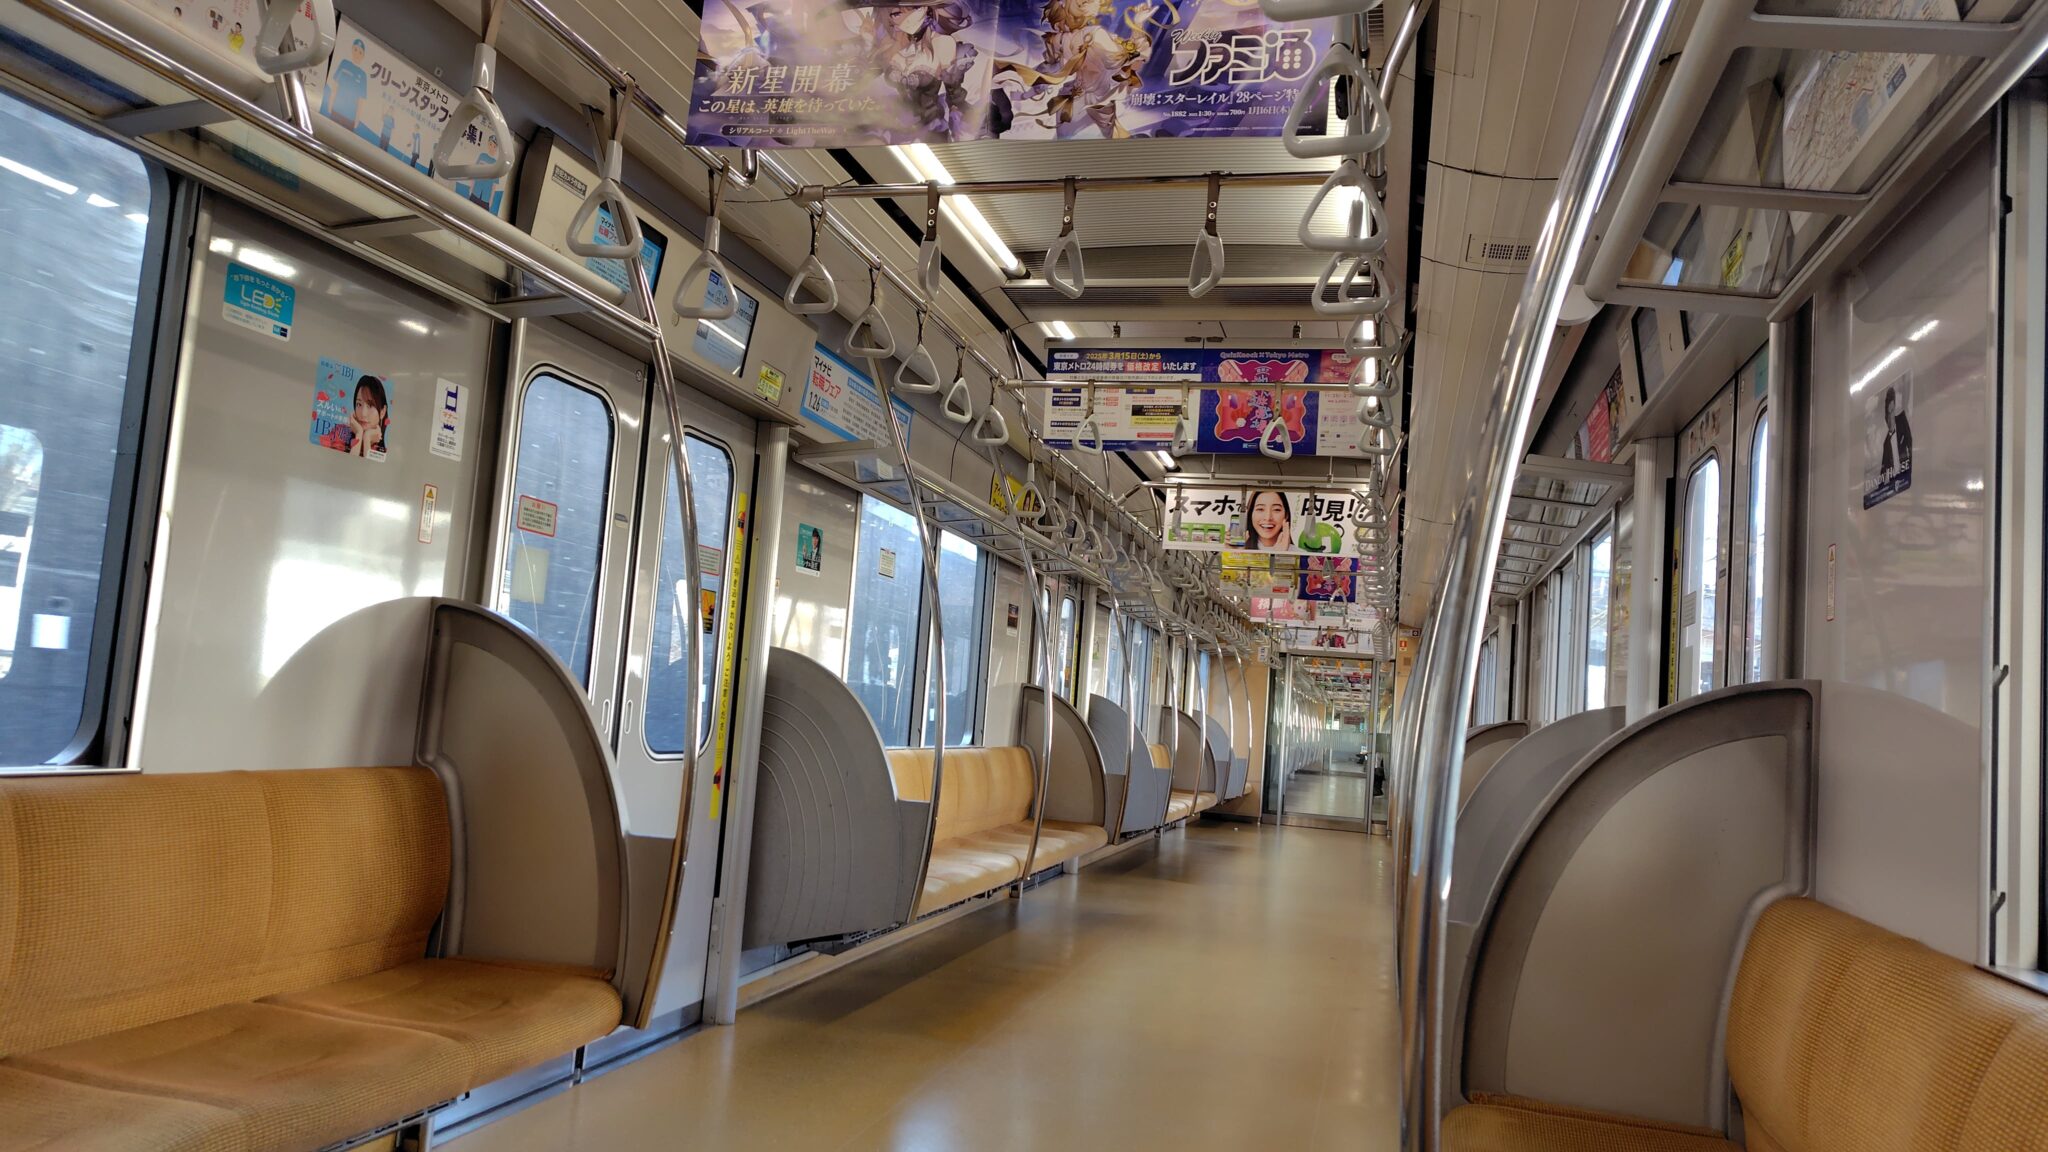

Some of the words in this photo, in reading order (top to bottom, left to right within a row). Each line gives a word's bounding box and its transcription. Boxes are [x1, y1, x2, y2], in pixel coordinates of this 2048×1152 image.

[1171, 28, 1223, 44] Weekly
[1168, 28, 1317, 87] ファミ通
[415, 76, 449, 105] 東京メトロ
[724, 63, 857, 96] 新星開幕
[369, 61, 484, 147] クリーンスタッフ集!
[698, 97, 883, 115] この星は、英雄を待っていた。
[241, 284, 275, 309] LED
[1265, 351, 1287, 360] Tokyo
[1287, 351, 1310, 359] Metro
[341, 366, 354, 381] IBJ
